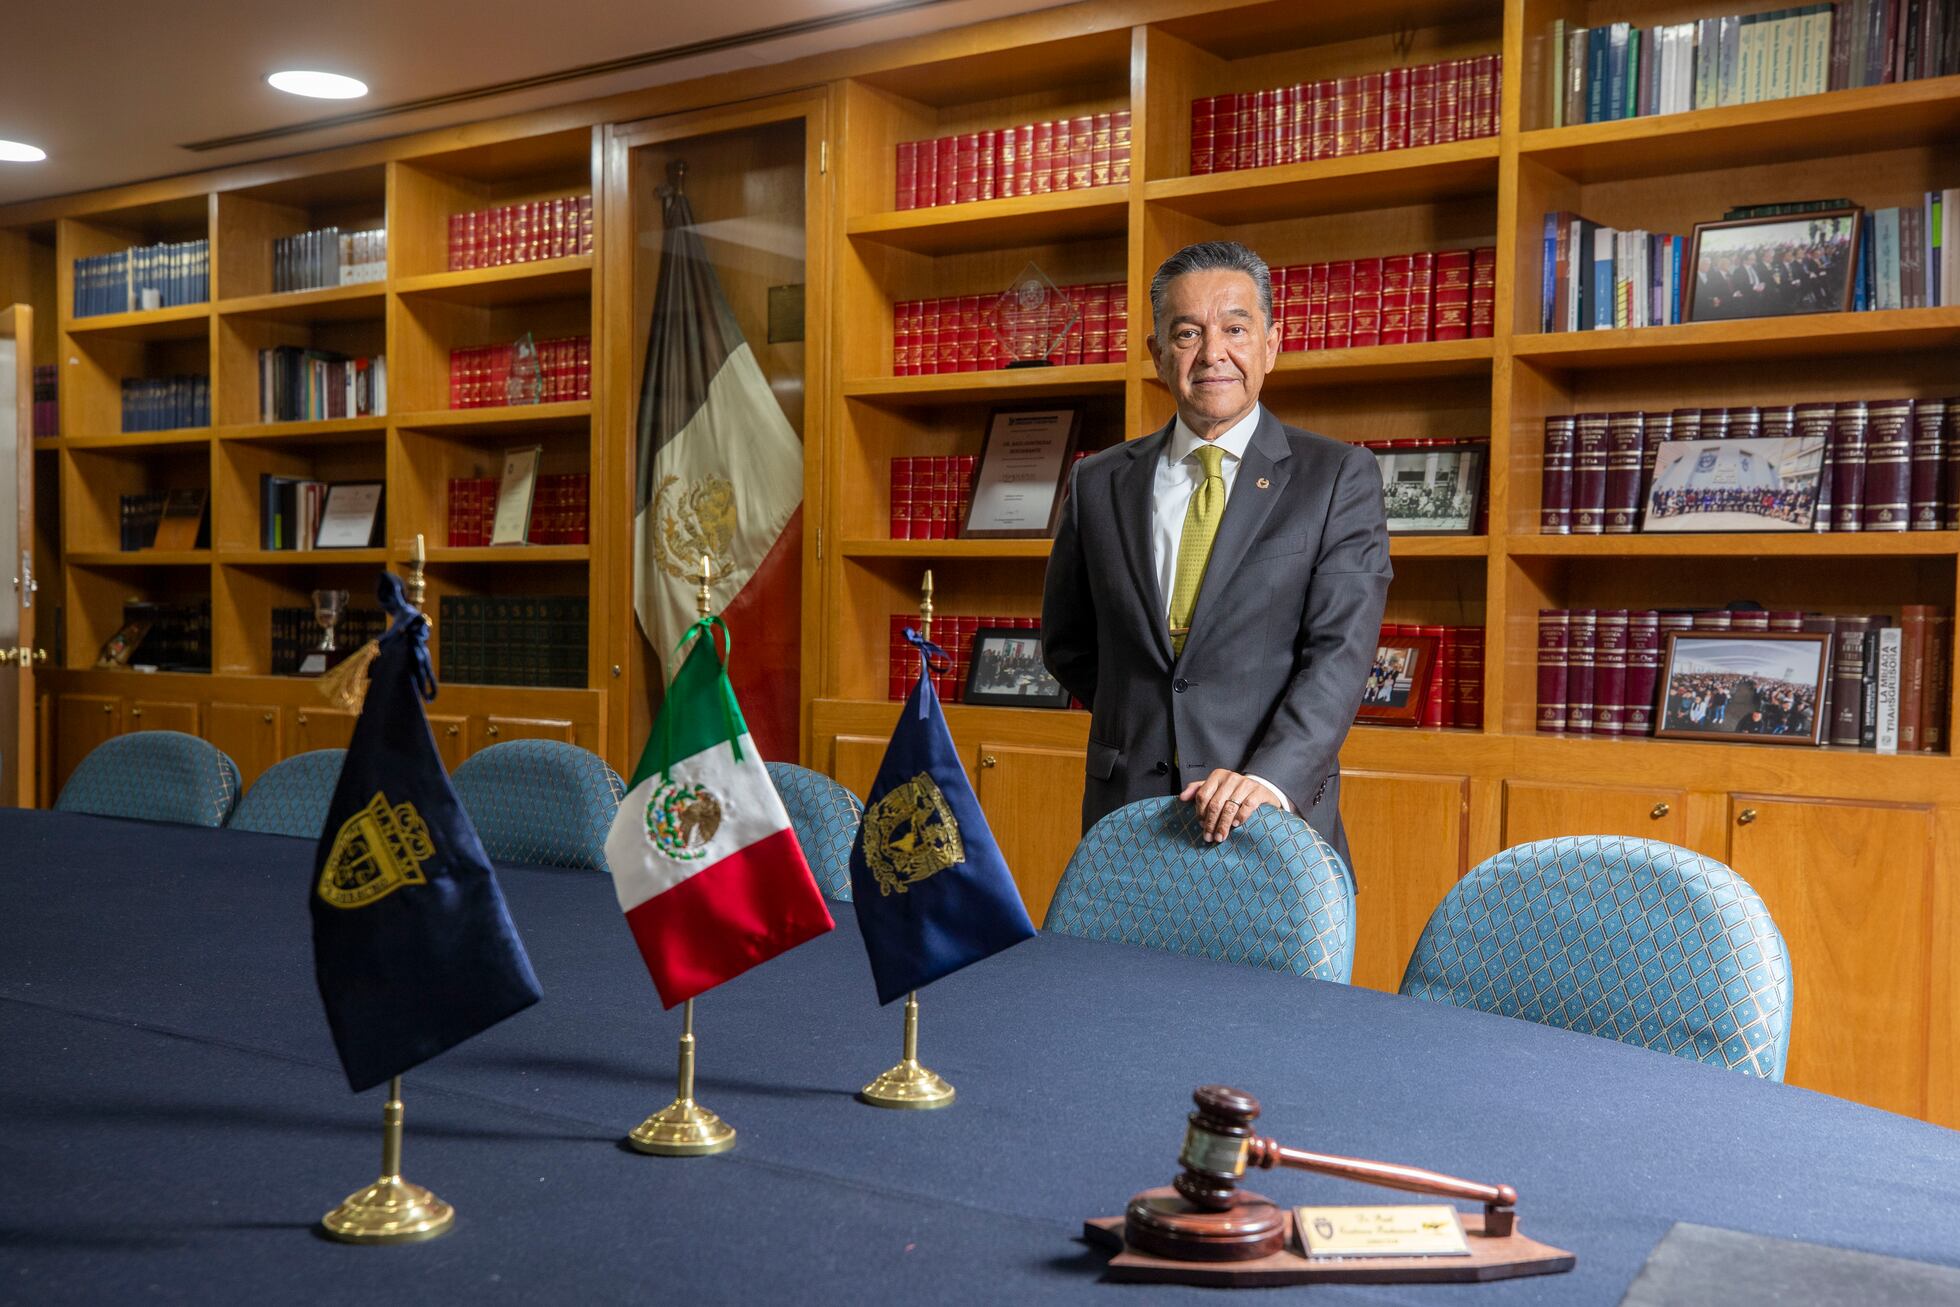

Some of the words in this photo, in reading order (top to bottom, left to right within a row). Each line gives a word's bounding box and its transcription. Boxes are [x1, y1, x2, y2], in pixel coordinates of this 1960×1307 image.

[1880, 646, 1889, 688] MIRADA
[1880, 690, 1888, 703] LA
[1887, 646, 1897, 732] TRANSGRESORA
